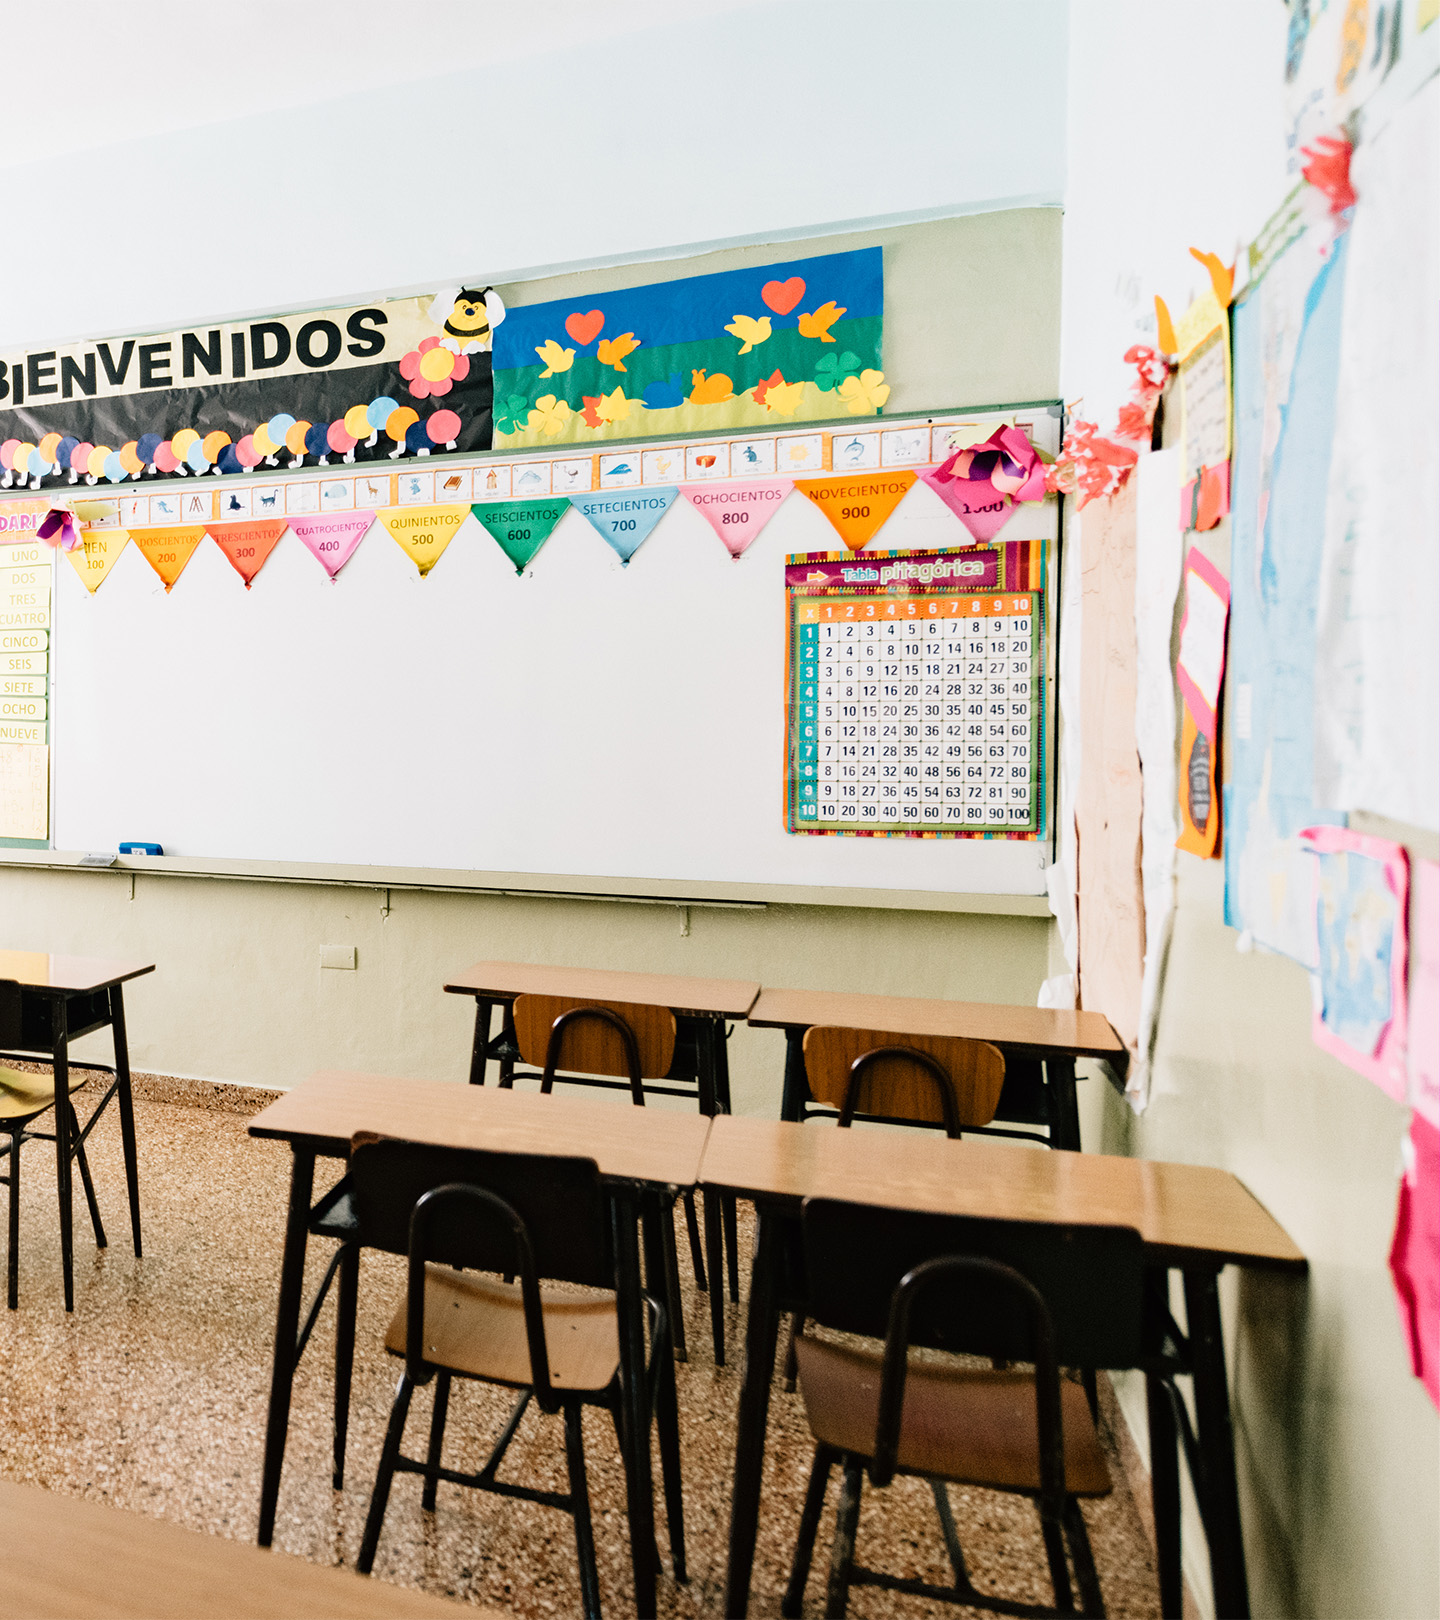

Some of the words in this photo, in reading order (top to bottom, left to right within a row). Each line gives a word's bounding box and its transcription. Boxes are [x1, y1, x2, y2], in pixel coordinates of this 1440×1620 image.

[692, 489, 783, 506] OCHOCIENTOS
[808, 482, 908, 500] NOVECIENTOS
[583, 497, 667, 516] SETECIENTOS
[841, 506, 870, 519] 900
[390, 513, 461, 530] QUINIENTOS
[485, 508, 559, 525] SEISCIENTOS
[722, 512, 749, 525] 800
[295, 521, 368, 537] CUATROCIENTOS
[611, 519, 637, 532] 700
[139, 533, 198, 548] DOSCIENTOS
[214, 528, 281, 544] TRESCIENTOS
[411, 533, 434, 546] 500
[507, 528, 532, 541] 600
[235, 546, 255, 559] 300
[318, 539, 340, 553] 400
[12, 550, 39, 562] UNO
[157, 552, 177, 564] 200
[87, 560, 104, 569] 100
[842, 568, 878, 582] Tabla
[880, 560, 985, 584] pitagórica
[12, 573, 36, 585] DOS
[9, 594, 36, 605] TRES
[825, 606, 833, 618] 1
[845, 605, 855, 618] 2
[866, 604, 875, 617] 3
[887, 604, 896, 616] 4
[907, 603, 916, 615] 5
[928, 602, 938, 615] 6
[950, 601, 959, 614] 7
[971, 600, 981, 613] 8
[993, 599, 1003, 612] 9
[1012, 598, 1029, 611] 10
[0, 612, 46, 625] CUATRO
[806, 628, 813, 639] 1
[826, 627, 832, 638] 1
[846, 626, 854, 637] 2
[866, 625, 874, 637] 3
[887, 624, 895, 635] 4
[908, 623, 916, 635] 5
[929, 623, 937, 635] 6
[952, 622, 958, 634] 7
[972, 621, 980, 633] 8
[994, 621, 1002, 632] 9
[1013, 619, 1029, 632] 10
[2, 636, 39, 648] CINCO
[805, 647, 814, 659] 2
[825, 646, 833, 658] 2
[846, 646, 853, 657] 4
[866, 645, 874, 657] 6
[887, 644, 895, 656] 8
[905, 644, 919, 655] 10
[926, 643, 940, 655] 12
[948, 643, 962, 654] 14
[969, 642, 984, 654] 16
[990, 641, 1005, 653] 18
[1012, 640, 1028, 653] 20
[8, 658, 32, 670] SEIS
[805, 666, 814, 678] 3
[825, 666, 833, 678] 3
[845, 665, 853, 677] 6
[866, 665, 874, 677] 9
[884, 664, 898, 676] 12
[905, 664, 919, 676] 15
[926, 664, 940, 675] 18
[946, 663, 960, 675] 21
[968, 663, 983, 674] 24
[989, 662, 1005, 674] 27
[1012, 661, 1028, 674] 30
[4, 682, 34, 694] SIETE
[804, 687, 814, 699] 4
[825, 686, 833, 697] 4
[845, 686, 853, 697] 8
[863, 685, 877, 697] 12
[884, 685, 898, 696] 16
[904, 684, 919, 696] 20
[925, 684, 940, 695] 24
[946, 683, 962, 696] 28
[968, 683, 983, 695] 32
[990, 683, 1005, 695] 36
[1012, 682, 1028, 694] 40
[2, 703, 36, 715] OCHO
[805, 706, 814, 718] 5
[825, 706, 833, 717] 5
[842, 705, 857, 717] 10
[862, 705, 877, 717] 15
[882, 705, 898, 717] 20
[903, 705, 918, 716] 25
[924, 704, 940, 716] 30
[946, 704, 962, 716] 35
[967, 704, 983, 716] 40
[989, 704, 1005, 715] 45
[1011, 703, 1027, 715] 50
[0, 727, 38, 740] NUEVE
